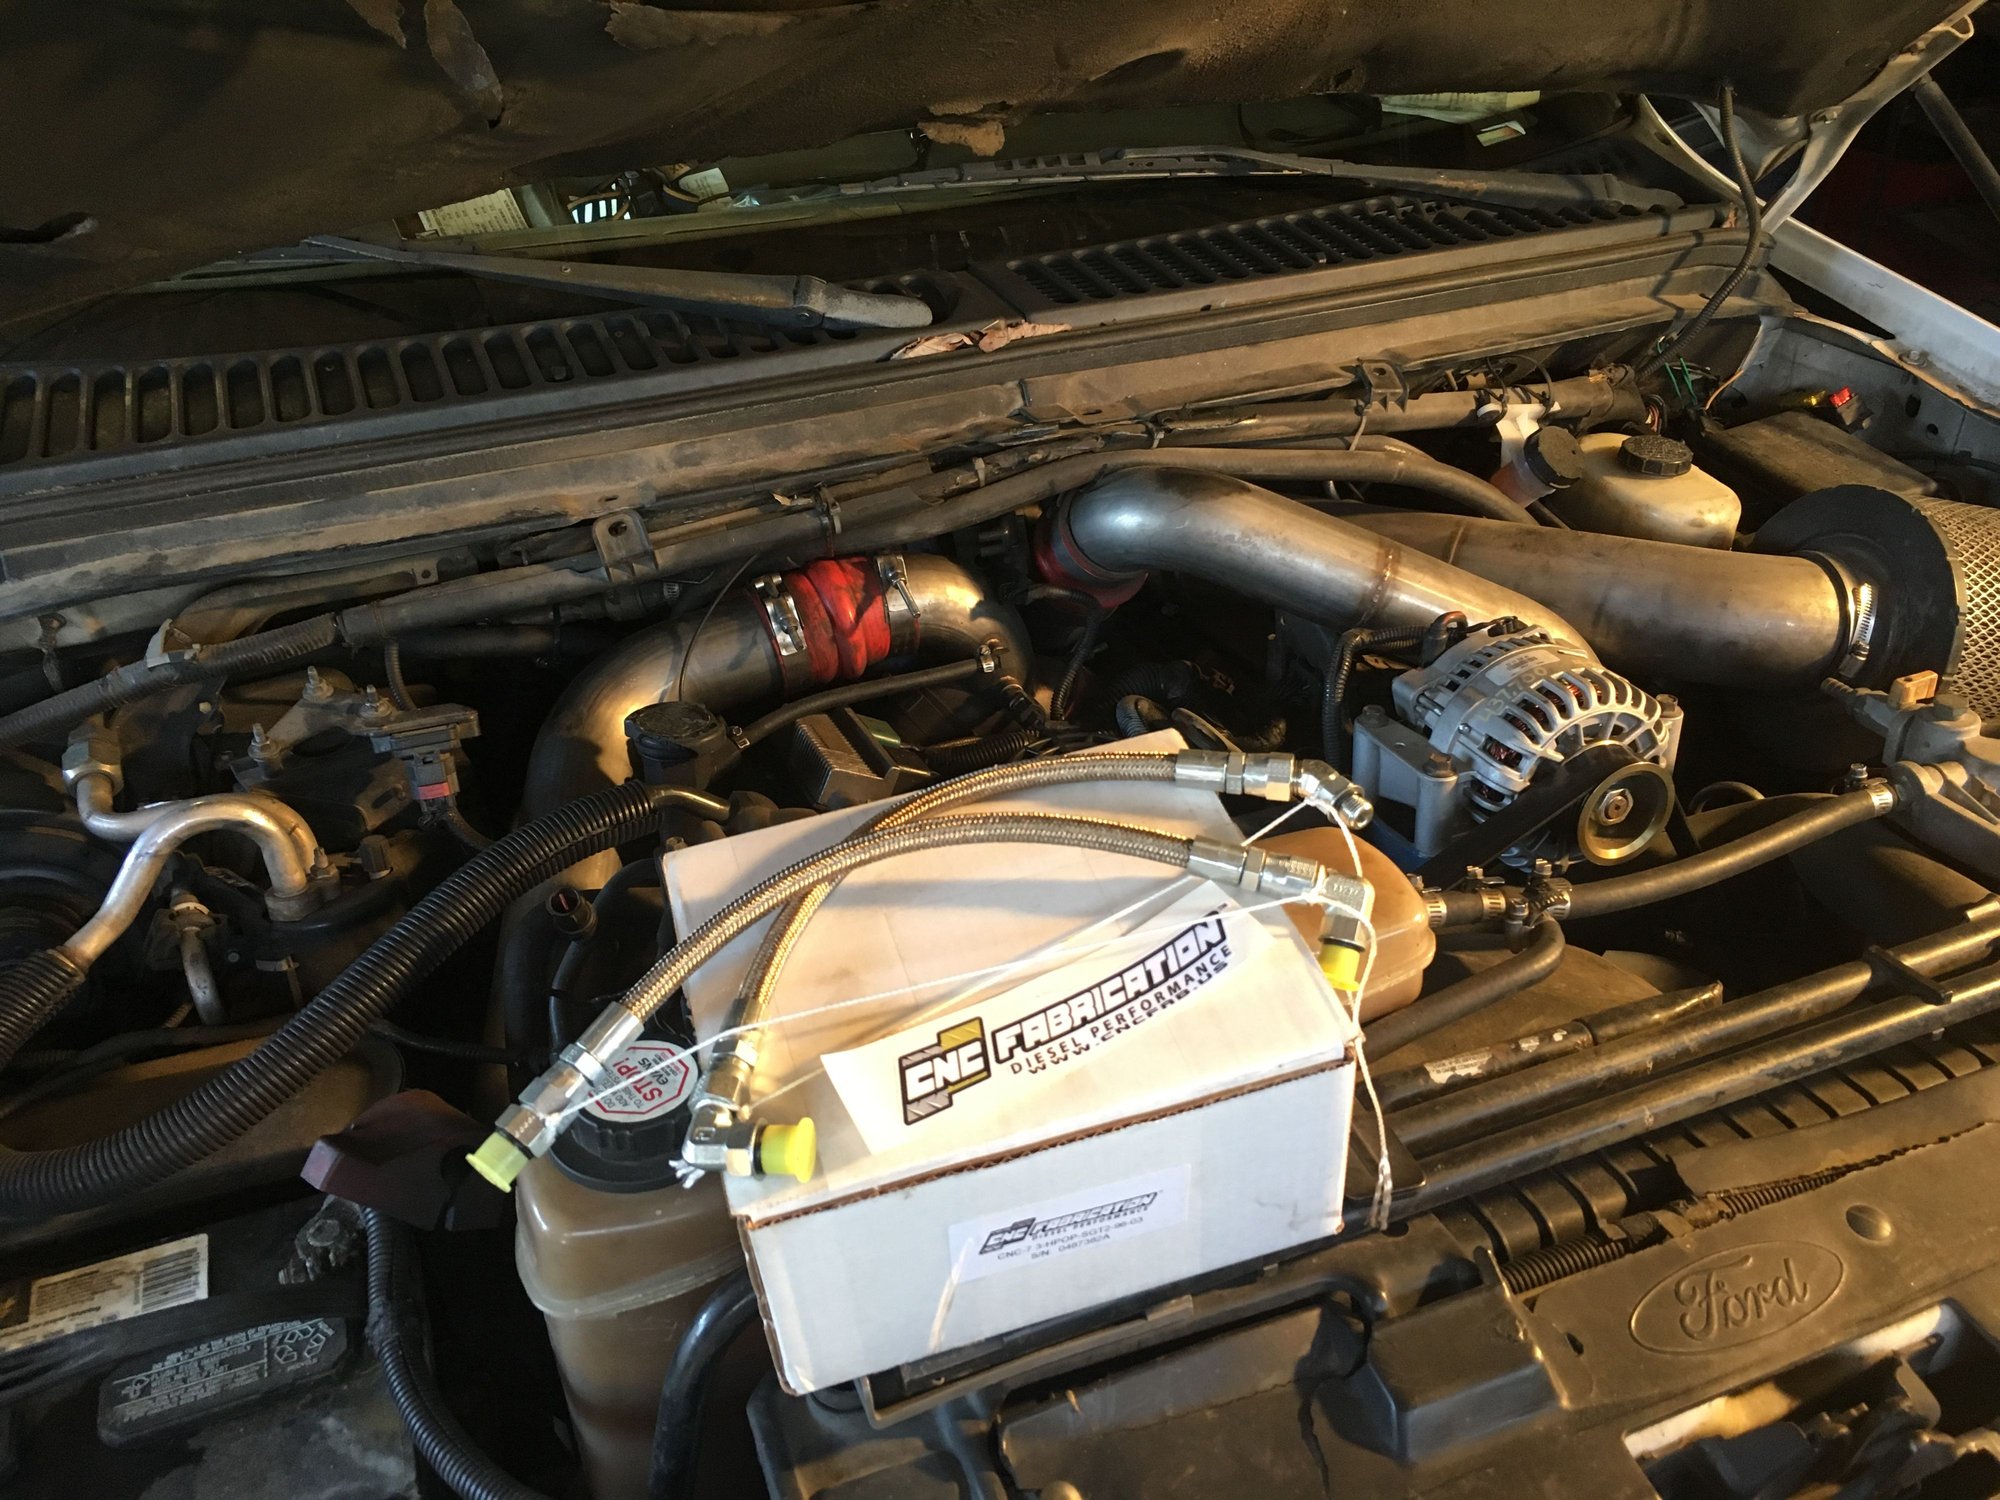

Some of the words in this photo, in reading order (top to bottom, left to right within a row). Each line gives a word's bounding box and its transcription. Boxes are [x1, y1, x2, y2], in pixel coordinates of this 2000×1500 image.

[902, 1038, 989, 1103] CNC
[993, 910, 1226, 1063] FABRICATION
[1010, 1037, 1081, 1074] DIESEL
[1091, 945, 1232, 1038] PERFORMANCE
[1029, 1191, 1158, 1236] FABRICATION
[1674, 1254, 1810, 1342] Ford
